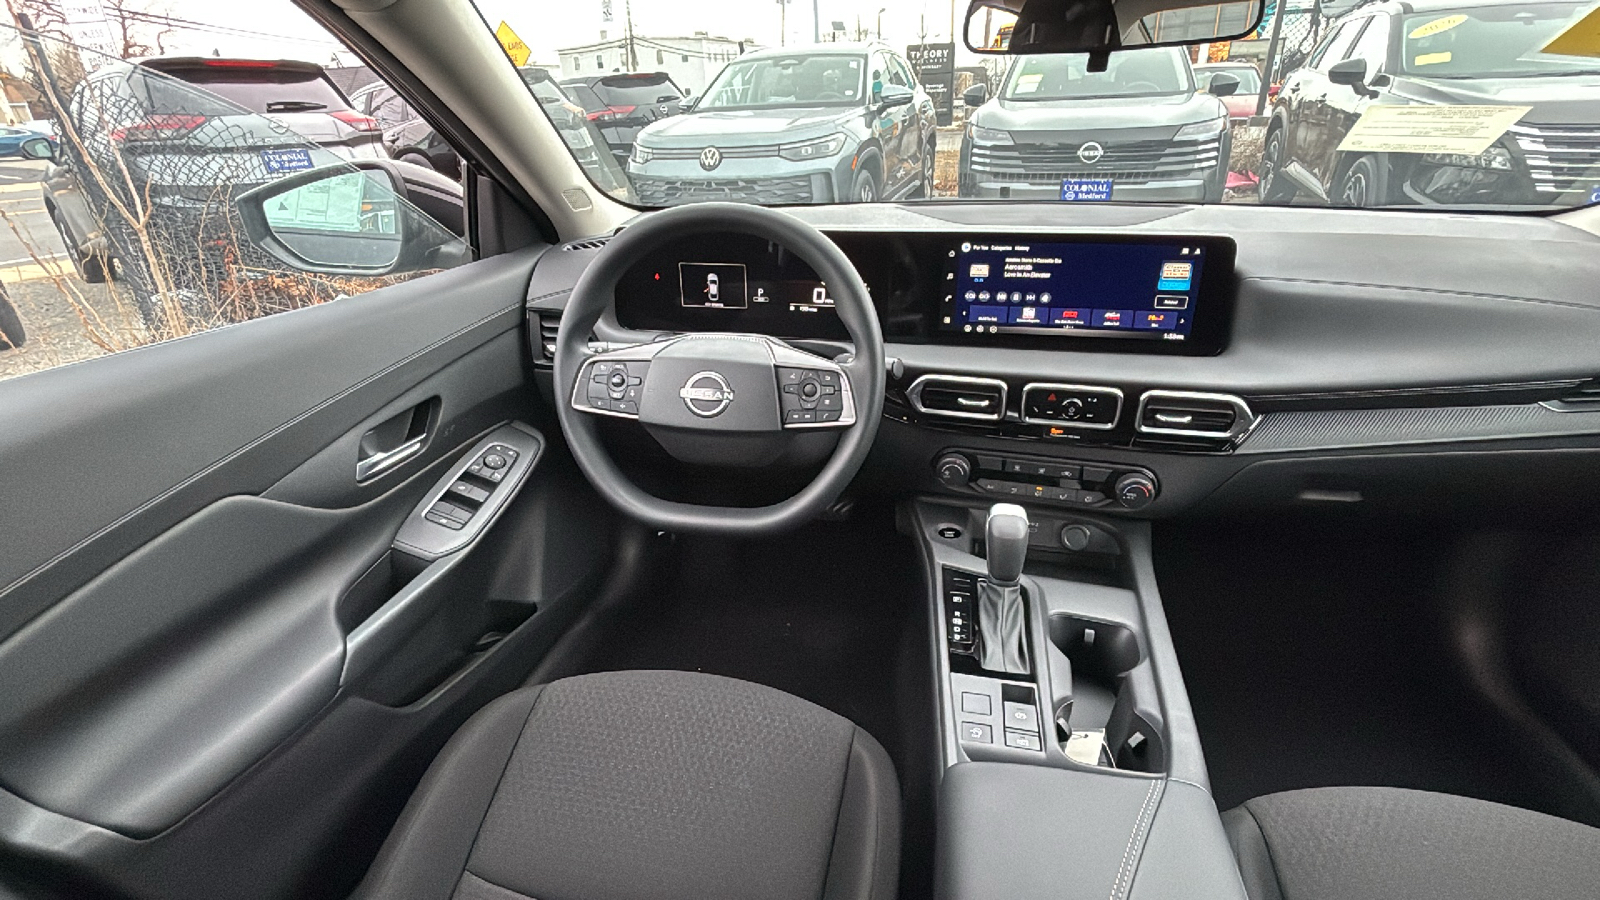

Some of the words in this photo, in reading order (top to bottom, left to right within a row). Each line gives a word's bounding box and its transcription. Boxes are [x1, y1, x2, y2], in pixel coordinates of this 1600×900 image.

[78, 29, 104, 39] UNLESS
[910, 49, 949, 59] THEORY
[1064, 184, 1110, 192] COLONIAL
[757, 288, 764, 297] P
[812, 288, 826, 304] 0
[681, 388, 734, 400] NISSAN
